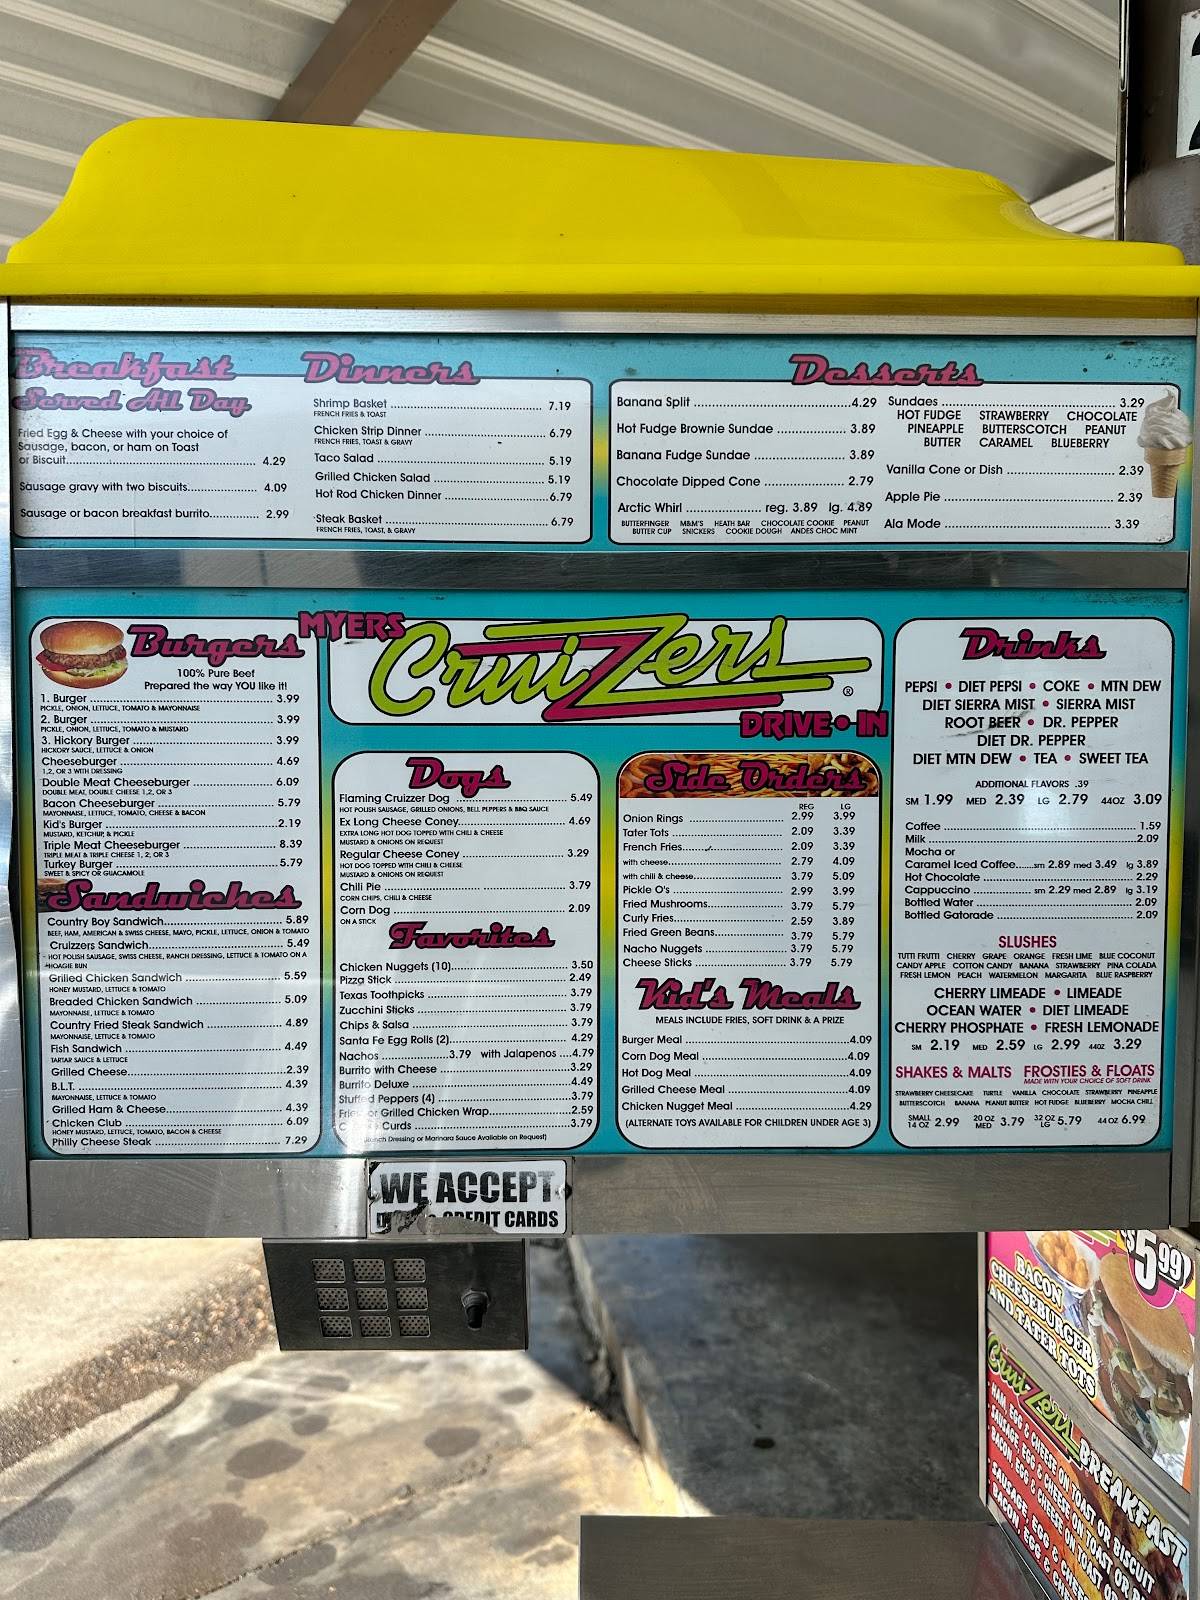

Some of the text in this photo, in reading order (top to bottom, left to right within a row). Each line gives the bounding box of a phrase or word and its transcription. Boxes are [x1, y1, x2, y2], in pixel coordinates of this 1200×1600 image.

[14, 348, 236, 387] Breakfast
[300, 351, 480, 384] Dinners
[789, 354, 984, 386] Desserts
[13, 387, 251, 417] Served All Day
[314, 399, 570, 410] Shrimp Basket 7.19
[618, 397, 877, 409] Banana Split 4.29
[888, 397, 1144, 408] Sundaes 3.29
[897, 410, 1137, 421] HOT FUDGE STRAWBERRY CHOCOLATE
[18, 429, 228, 441] Fried Egg & Cheese with your choice of
[314, 426, 572, 438] Chicken Strip Dinner 6.79
[617, 424, 875, 436] Hot Fudge Brownie Sundae 3.89
[908, 424, 1126, 434] PINEAPPLE BUTTERSCOTCH PEANUT
[342, 438, 360, 446] FRIES,
[924, 438, 1110, 448] BUTTER CARAMEL BLUEBERRY
[315, 453, 572, 466] Taco Salad 5.19
[885, 492, 1142, 503] Apple Pie 2.39
[618, 503, 872, 514] Arctic Whirl reg. 3.89 lg. 4.89
[299, 611, 405, 640] MYERS
[127, 624, 305, 667] Burgers
[959, 627, 1107, 660] Drinks
[177, 669, 255, 678] 100% Pure Beef
[905, 680, 1161, 692] PEPSI DIET PEPSI COKE MTN DEW
[41, 694, 299, 705] 1. Burger 3.99
[405, 757, 511, 798] Dogs
[645, 760, 867, 792] Side Orders
[975, 780, 1089, 788] ADDITIONAL FLAVORS .39
[340, 849, 589, 860] Regular Cheese Coney 3.29
[45, 880, 302, 911] Sandwiches
[623, 886, 855, 895] Pickle O's 2.99 3.99
[389, 921, 555, 949] Favorites
[999, 936, 1056, 948] SLUSHES
[340, 988, 592, 1000] Texas Toothpicks 3.79
[635, 978, 861, 1010] Kid's Meals
[934, 988, 1122, 999] CHERRY LIMEADE LIMEADE
[656, 1016, 683, 1024] MEALS
[686, 1016, 722, 1024] INCLUDE
[725, 1016, 750, 1025] FRIES,
[752, 1016, 773, 1024] SOFT
[776, 1016, 802, 1024] DRINK
[896, 1065, 1154, 1078] SHAKES & MALTS FROSTIES & FLOATS
[51, 1080, 308, 1091] B.L.T. 4.39
[380, 1171, 555, 1203] WE ACCEPT
[505, 1211, 558, 1227] CARDS
[1015, 1253, 1063, 1309] BACON
[991, 1259, 1093, 1367] CHEESEBURGER
[989, 1283, 1096, 1398] AND TATER TOTS
[991, 1382, 1008, 1415] HAM,
[1009, 1404, 1023, 1430] EGG
[1031, 1431, 1058, 1474] CHEESE
[1058, 1467, 1070, 1492] ON
[1071, 1483, 1097, 1525] TOAST
[1097, 1519, 1111, 1548] OR
[1113, 1537, 1155, 1594] BISCUIT
[1079, 1438, 1187, 1568] BREAKFAST
